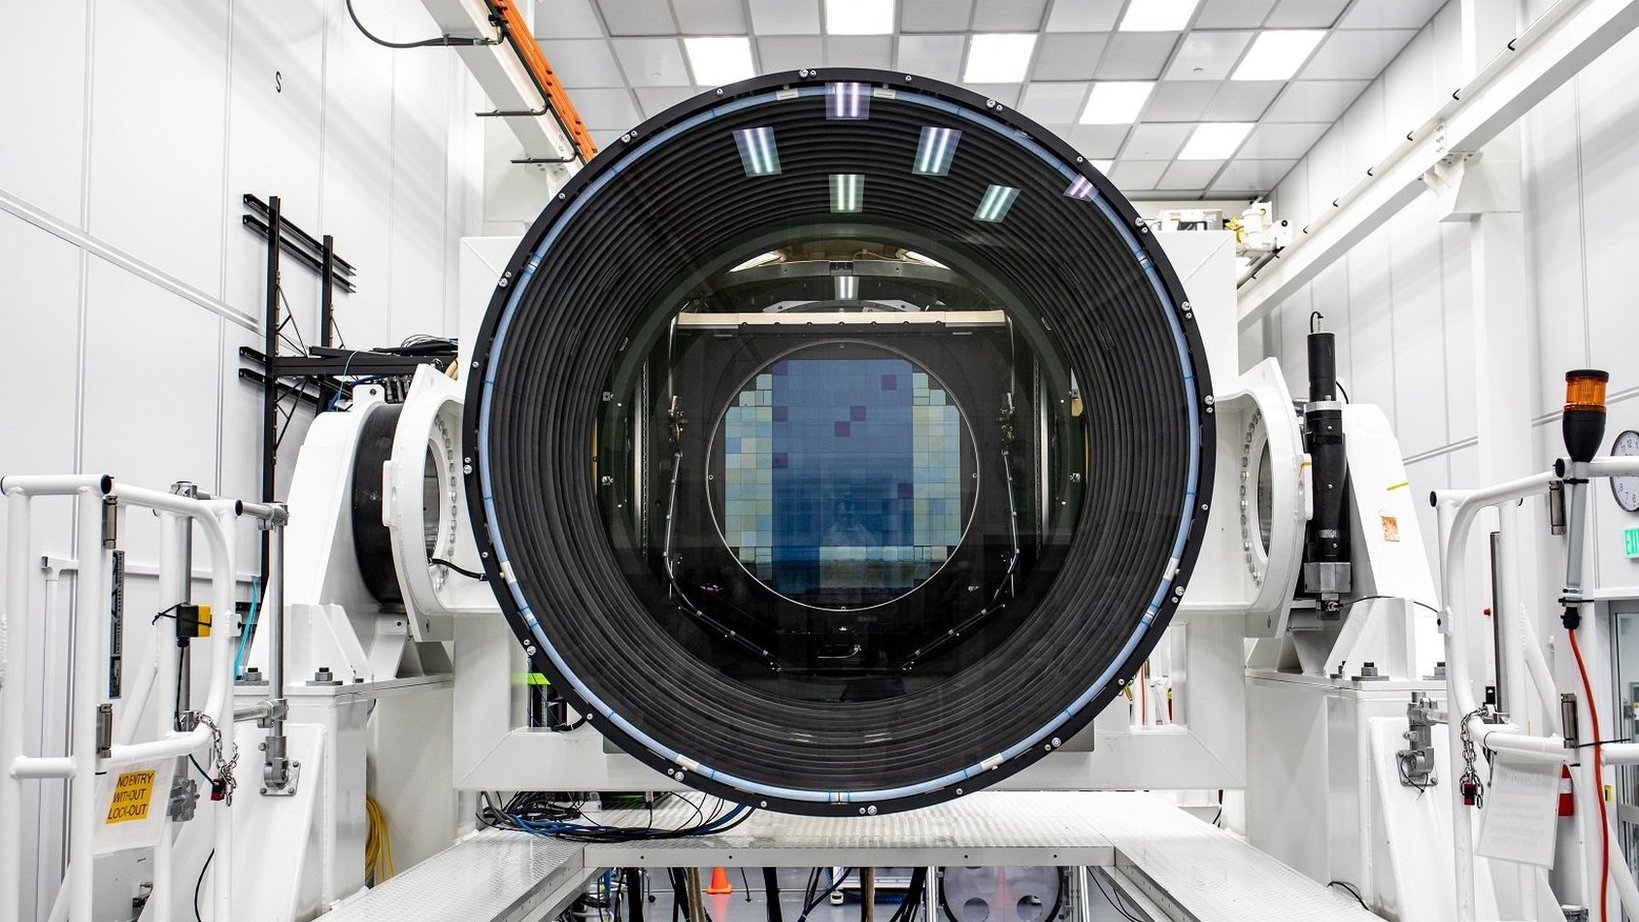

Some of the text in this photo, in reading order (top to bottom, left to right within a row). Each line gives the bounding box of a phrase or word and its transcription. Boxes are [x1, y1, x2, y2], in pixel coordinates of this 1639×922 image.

[275, 71, 282, 93] S
[1625, 529, 1639, 555] EXI
[117, 772, 154, 788] NO ENTRY
